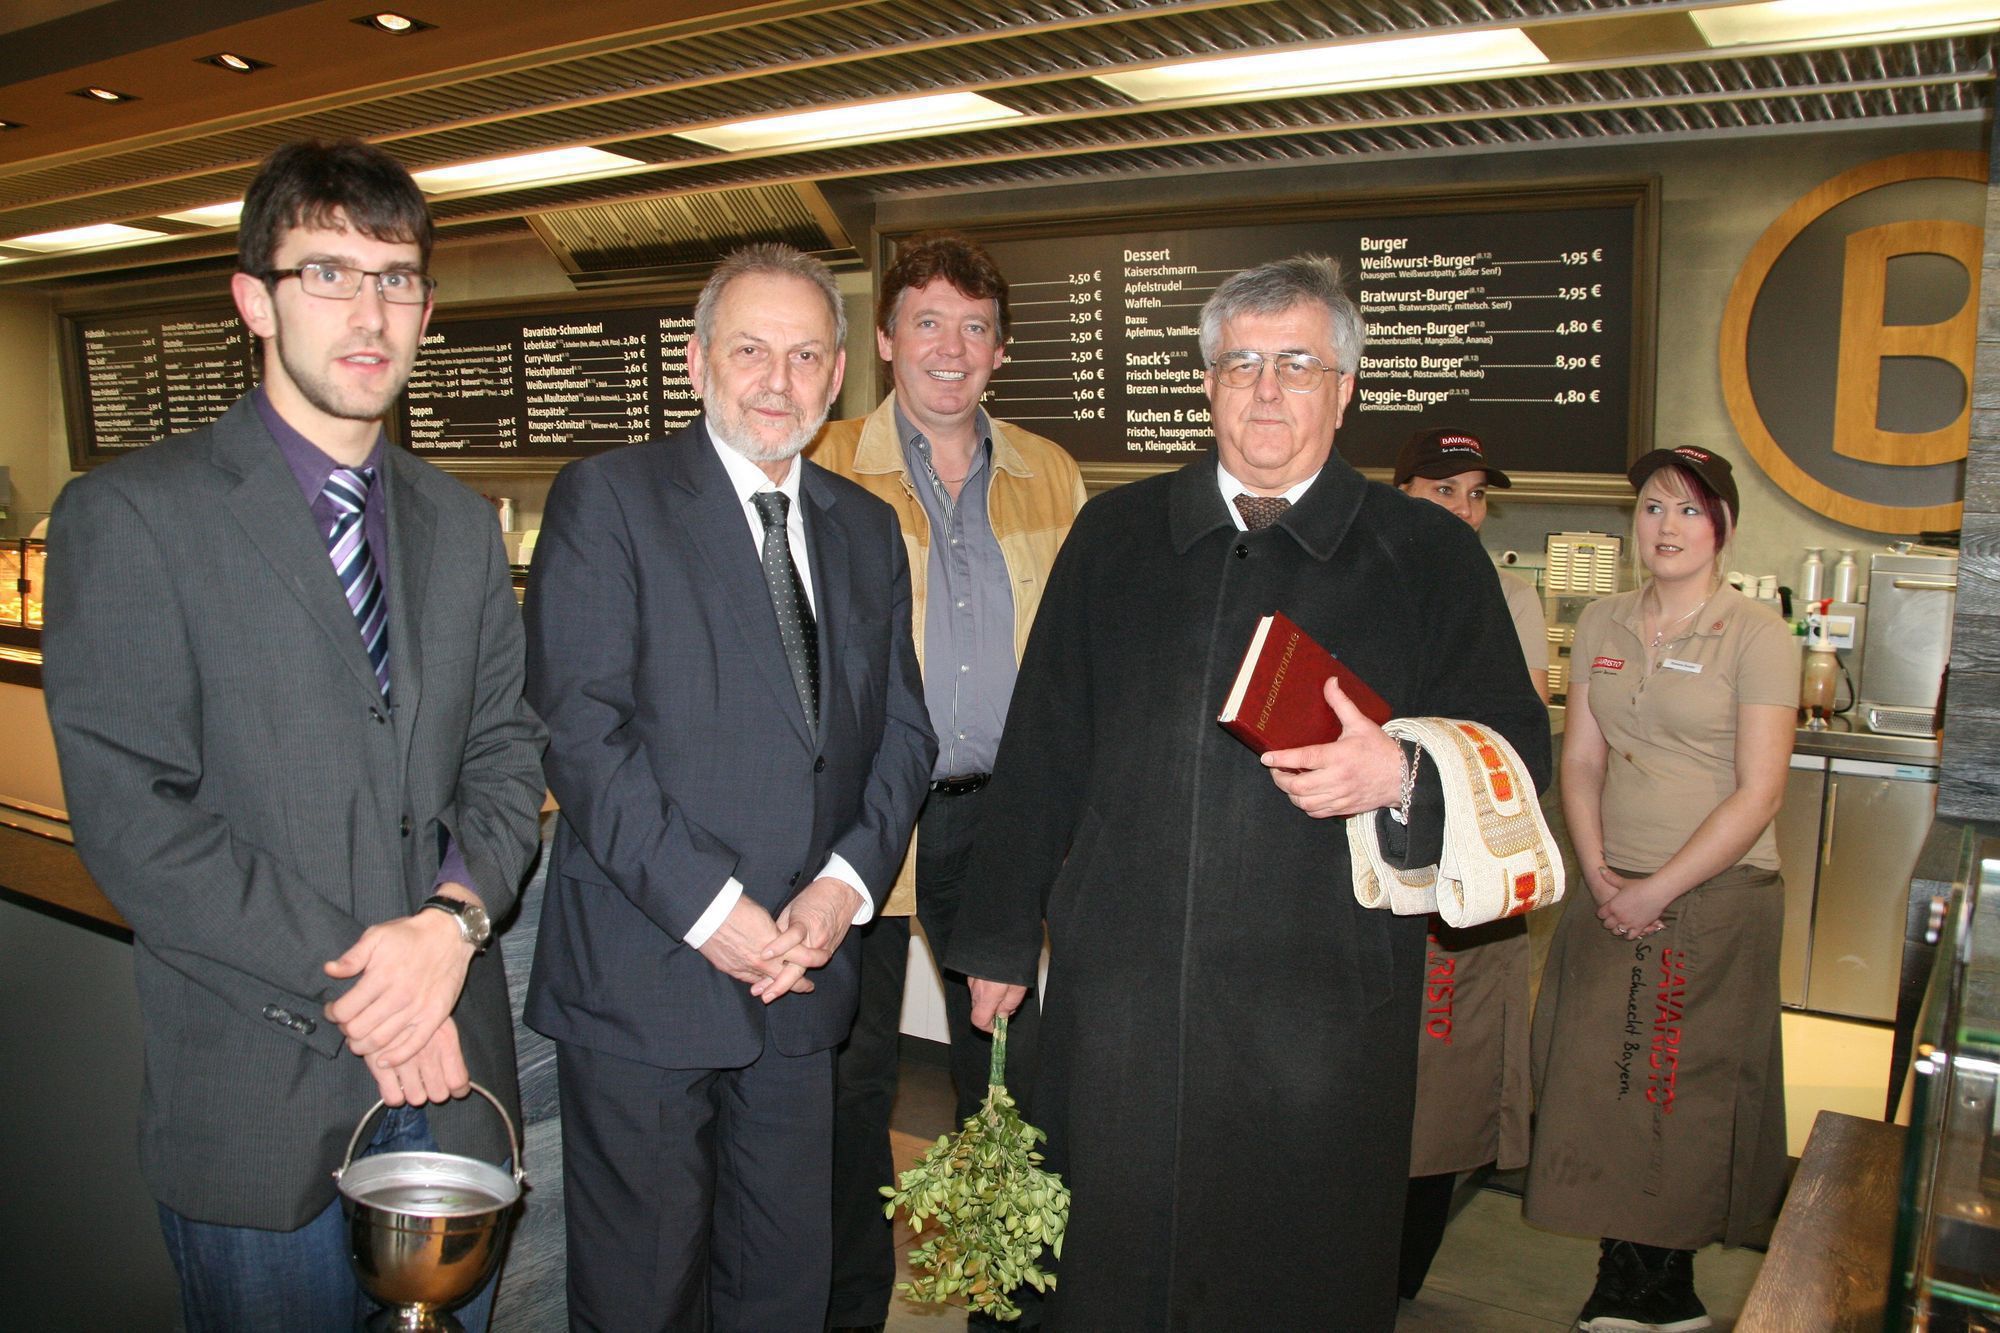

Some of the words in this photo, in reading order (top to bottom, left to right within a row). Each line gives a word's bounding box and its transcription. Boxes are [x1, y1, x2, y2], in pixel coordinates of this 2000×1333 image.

[1361, 237, 1408, 253] Burger
[1124, 248, 1170, 262] Dessert
[1361, 254, 1476, 269] Weißwurst-Burger
[1561, 252, 1588, 265] 1,95
[1592, 248, 1602, 262] €
[1069, 274, 1090, 284] 2,50
[1094, 270, 1101, 281] €
[1124, 265, 1197, 277] Kaiserschmarrn
[1360, 271, 1397, 280] (hausgem.
[1399, 270, 1457, 278] Weißwurstpatty,
[1459, 268, 1479, 276] süßer
[1482, 267, 1501, 276] Senf)
[1125, 280, 1182, 295] Apfelstrudel
[1361, 289, 1469, 303] Bratwurst-Burger
[1558, 287, 1587, 300] 2,95
[1591, 284, 1602, 297] €
[1070, 293, 1091, 304] 2,50
[1094, 290, 1102, 301] €
[1125, 297, 1161, 308] Waffeln
[1360, 305, 1397, 313] (Hausgem.
[1399, 303, 1453, 312] Bratwurstpatty,
[1455, 302, 1490, 310] mittelsch.
[1491, 301, 1512, 310] Senf)
[660, 318, 696, 328] Hähnchen
[1070, 313, 1092, 324] 2,50
[1094, 310, 1102, 321] €
[1125, 316, 1148, 324] Dazu:
[523, 322, 603, 337] Bavaristo-Schmankerl
[1126, 327, 1164, 339] Apfelmus,
[1556, 320, 1588, 335] 4,80
[1592, 320, 1602, 332] €
[524, 340, 556, 350] Leberkäse
[623, 336, 639, 345] 2,80
[641, 335, 646, 344] €
[1070, 332, 1092, 343] 2,50
[1095, 330, 1103, 340] €
[1366, 337, 1423, 345] ähnchenbrustfilet,
[1425, 337, 1464, 346] Mangosoße,
[1466, 336, 1493, 345] Ananas)
[1833, 219, 1985, 466] B
[508, 342, 512, 350] €
[524, 354, 562, 365] Curry-Wurst
[624, 351, 638, 360] 3,10
[640, 349, 645, 358] €
[1071, 352, 1092, 363] 2,50
[1095, 349, 1103, 360] €
[1360, 356, 1418, 368] Bavaristo
[1421, 356, 1463, 371] Burger
[1555, 355, 1586, 369] 8,90
[1590, 355, 1601, 368] €
[525, 366, 574, 378] Fleischpflanzerl
[625, 364, 640, 374] 2,60
[642, 363, 648, 372] €
[1072, 371, 1094, 382] 1,60
[1097, 369, 1104, 380] €
[1126, 370, 1152, 380] Frisch
[1155, 369, 1190, 382] belegte
[1360, 370, 1412, 378] (Lenden-Steak,
[1414, 370, 1458, 378] Röstzwiebel,
[1460, 370, 1484, 378] Relish)
[526, 379, 588, 391] Weißwurstpflanzerl
[625, 379, 640, 388] 2,90
[642, 377, 648, 386] €
[1126, 384, 1158, 394] Brezen
[1160, 385, 1168, 394] in
[1170, 384, 1205, 393] wechsel
[544, 393, 579, 403] Maultaschen
[626, 394, 641, 403] 3,20
[643, 391, 648, 400] €
[1073, 390, 1094, 402] 1,60
[1097, 388, 1105, 399] €
[1360, 389, 1449, 404] Veggie-Burger
[1554, 390, 1586, 404] 4,80
[1590, 390, 1600, 402] €
[410, 406, 433, 417] Suppen
[528, 407, 565, 418] Käsespätzle
[626, 407, 642, 416] 4,90
[644, 405, 650, 414] €
[1360, 403, 1423, 412] (Gemüseschnitzel)
[511, 417, 516, 425] €
[1073, 409, 1094, 421] 1,60
[1097, 408, 1105, 419] €
[1127, 409, 1171, 422] Kuchen
[1174, 410, 1183, 422] &
[1187, 408, 1211, 422] Geb
[528, 420, 585, 431] Knusper-Schnitzel
[627, 420, 642, 429] 2,80
[645, 419, 650, 428] €
[512, 428, 516, 436] €
[529, 434, 551, 443] Cordon
[552, 433, 566, 443] bleu
[628, 435, 642, 444] 3,50
[645, 433, 650, 442] €
[1127, 427, 1158, 438] Frische,
[1160, 426, 1215, 439] hausgemach
[1127, 442, 1143, 452] ten,
[1145, 441, 1196, 453] Kleingebäck
[1635, 942, 1651, 961] So
[1426, 950, 1456, 1039] RISTO
